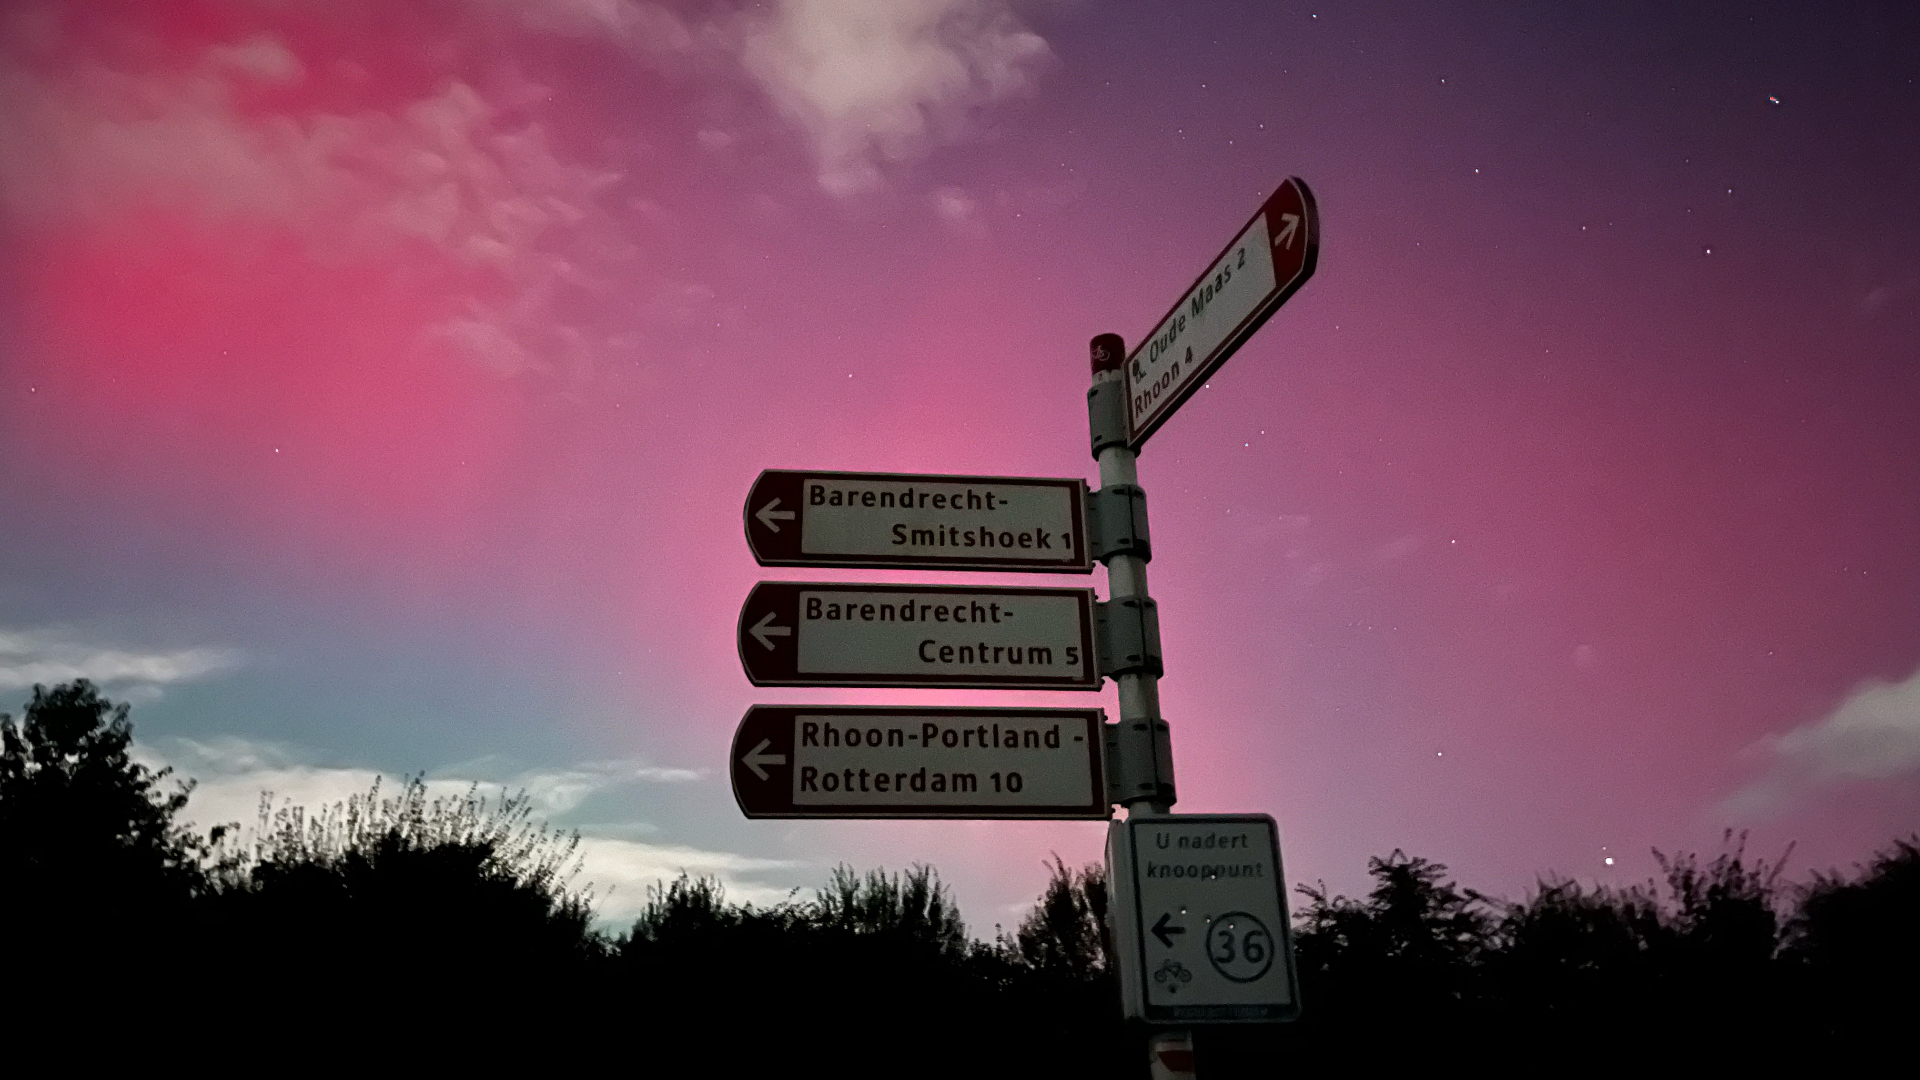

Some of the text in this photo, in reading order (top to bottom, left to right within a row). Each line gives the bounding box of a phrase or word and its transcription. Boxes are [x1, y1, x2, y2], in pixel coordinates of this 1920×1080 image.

[1150, 247, 1246, 364] Oude Maas 2
[1134, 346, 1194, 418] Rhoon 4
[810, 484, 1009, 510] Barendrecht-
[891, 523, 1072, 550] Smitshoek 1
[806, 597, 1014, 623] Barendrecht-
[918, 639, 1079, 665] Centrum 5
[802, 722, 1061, 749] Rhoon-Portland
[800, 766, 1024, 793] Rotterdam 10
[1156, 832, 1250, 849] U nadert
[1147, 861, 1265, 882] knooppunt
[1215, 929, 1265, 964] 36
